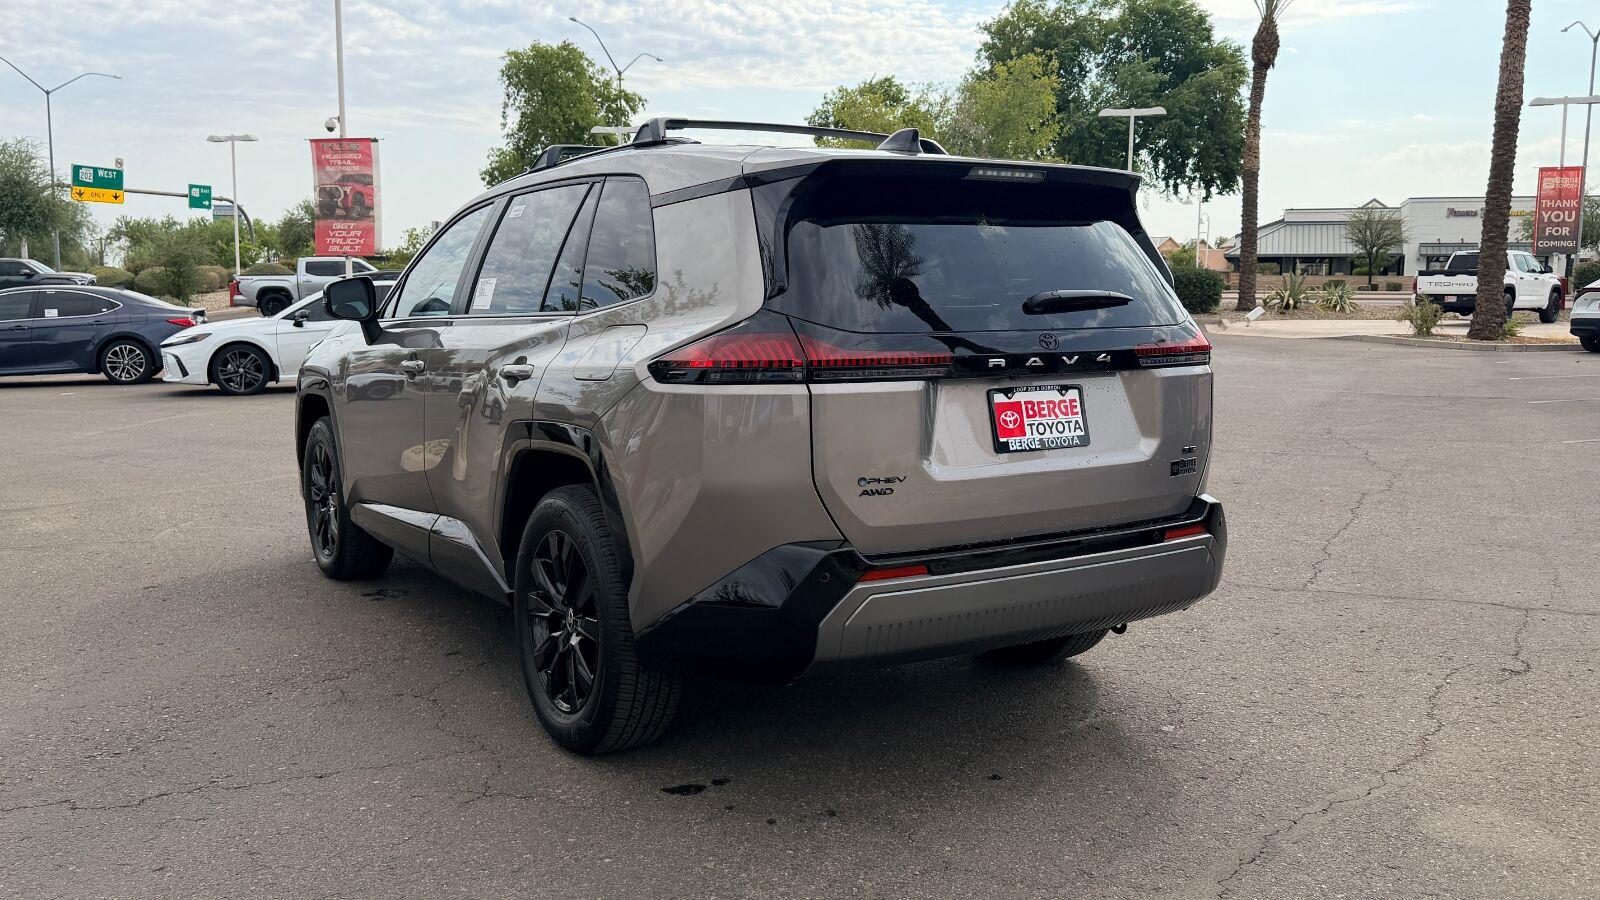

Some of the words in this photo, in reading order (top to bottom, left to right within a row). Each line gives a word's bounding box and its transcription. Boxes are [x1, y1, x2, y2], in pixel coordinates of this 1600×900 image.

[80, 171, 93, 182] 202
[97, 169, 117, 179] WEST
[91, 191, 106, 199] ONLY
[1541, 199, 1579, 208] THANK
[1541, 210, 1576, 223] YOU
[332, 222, 357, 230] GET
[1545, 226, 1570, 236] FOR
[1538, 240, 1576, 248] COMING!
[1023, 398, 1079, 420] BERGE
[1026, 420, 1084, 436] TOYOTA
[1008, 437, 1041, 451] BERGE
[1043, 436, 1081, 448] TOYOTA
[867, 475, 908, 485] PHEV
[858, 487, 895, 497] AWD
